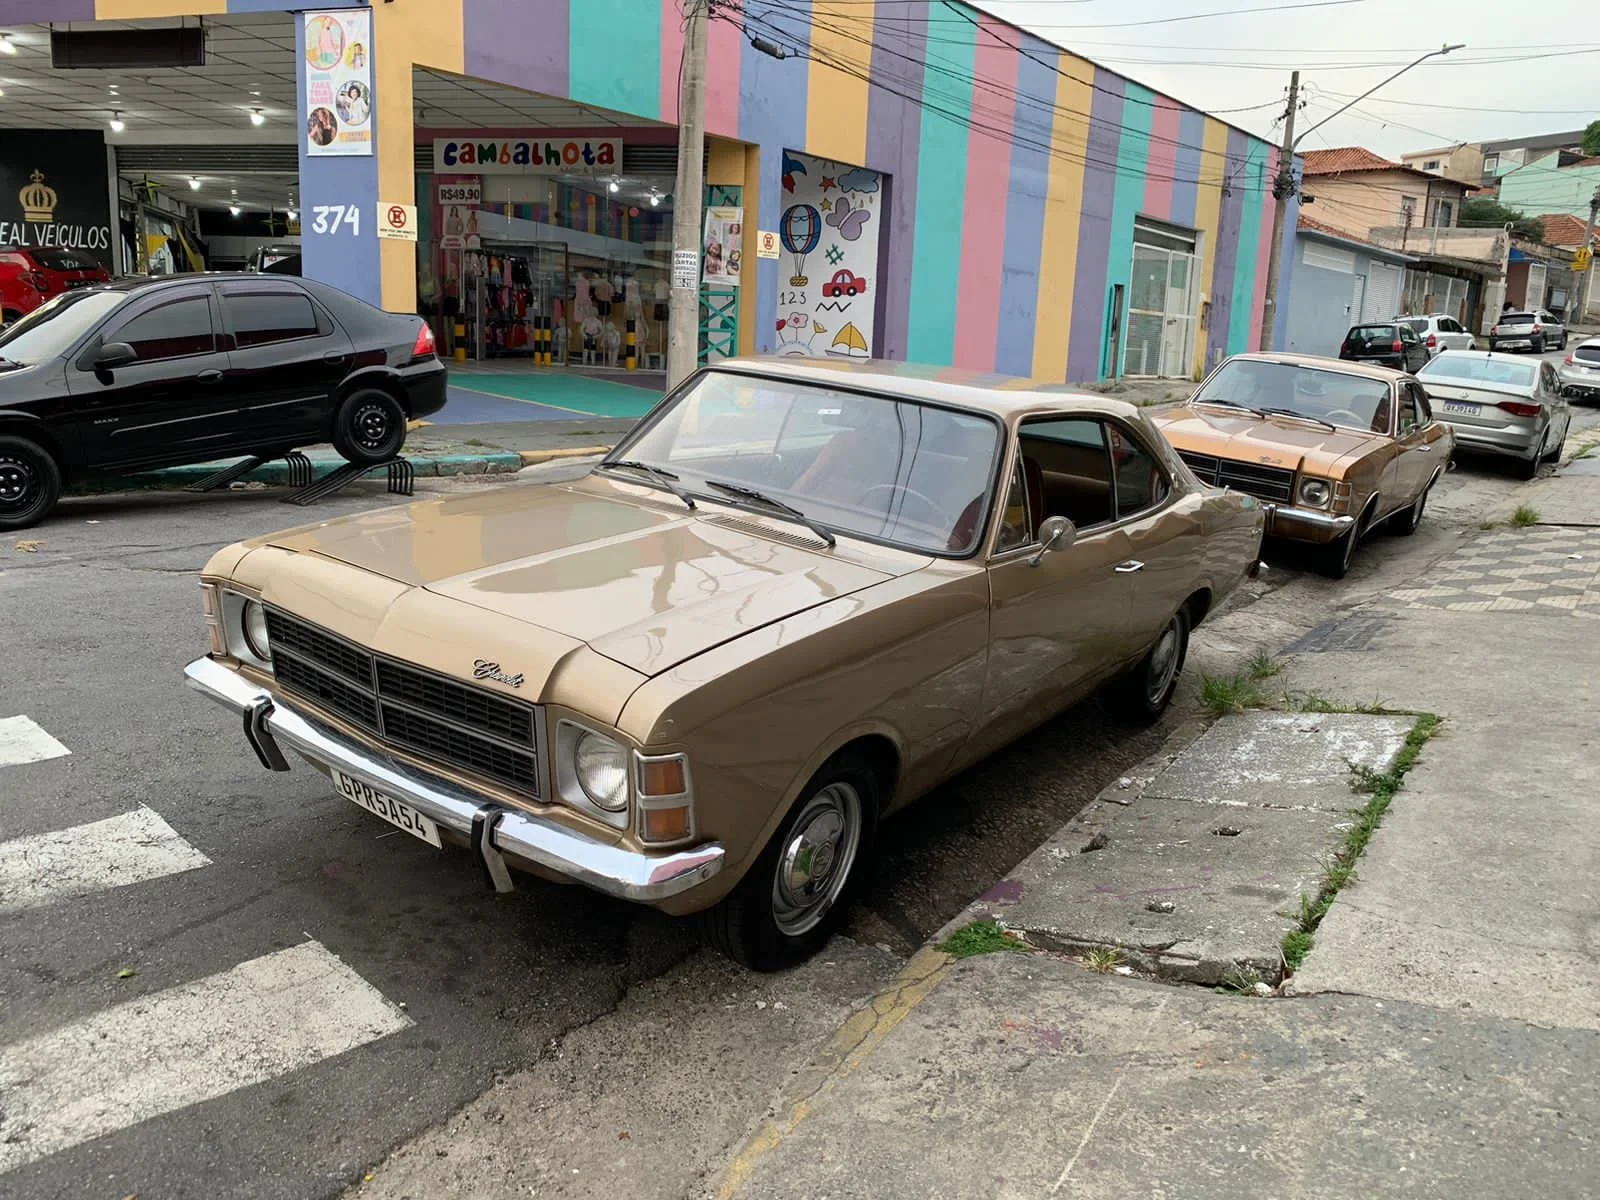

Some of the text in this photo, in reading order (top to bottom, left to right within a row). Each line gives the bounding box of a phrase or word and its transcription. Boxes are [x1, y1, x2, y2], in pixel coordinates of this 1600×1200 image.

[443, 142, 616, 166] cambalhota
[440, 187, 480, 201] R$49,90
[312, 204, 360, 236] 374
[34, 222, 110, 249] VEÍCULOS
[340, 772, 427, 837] GPR5A54
